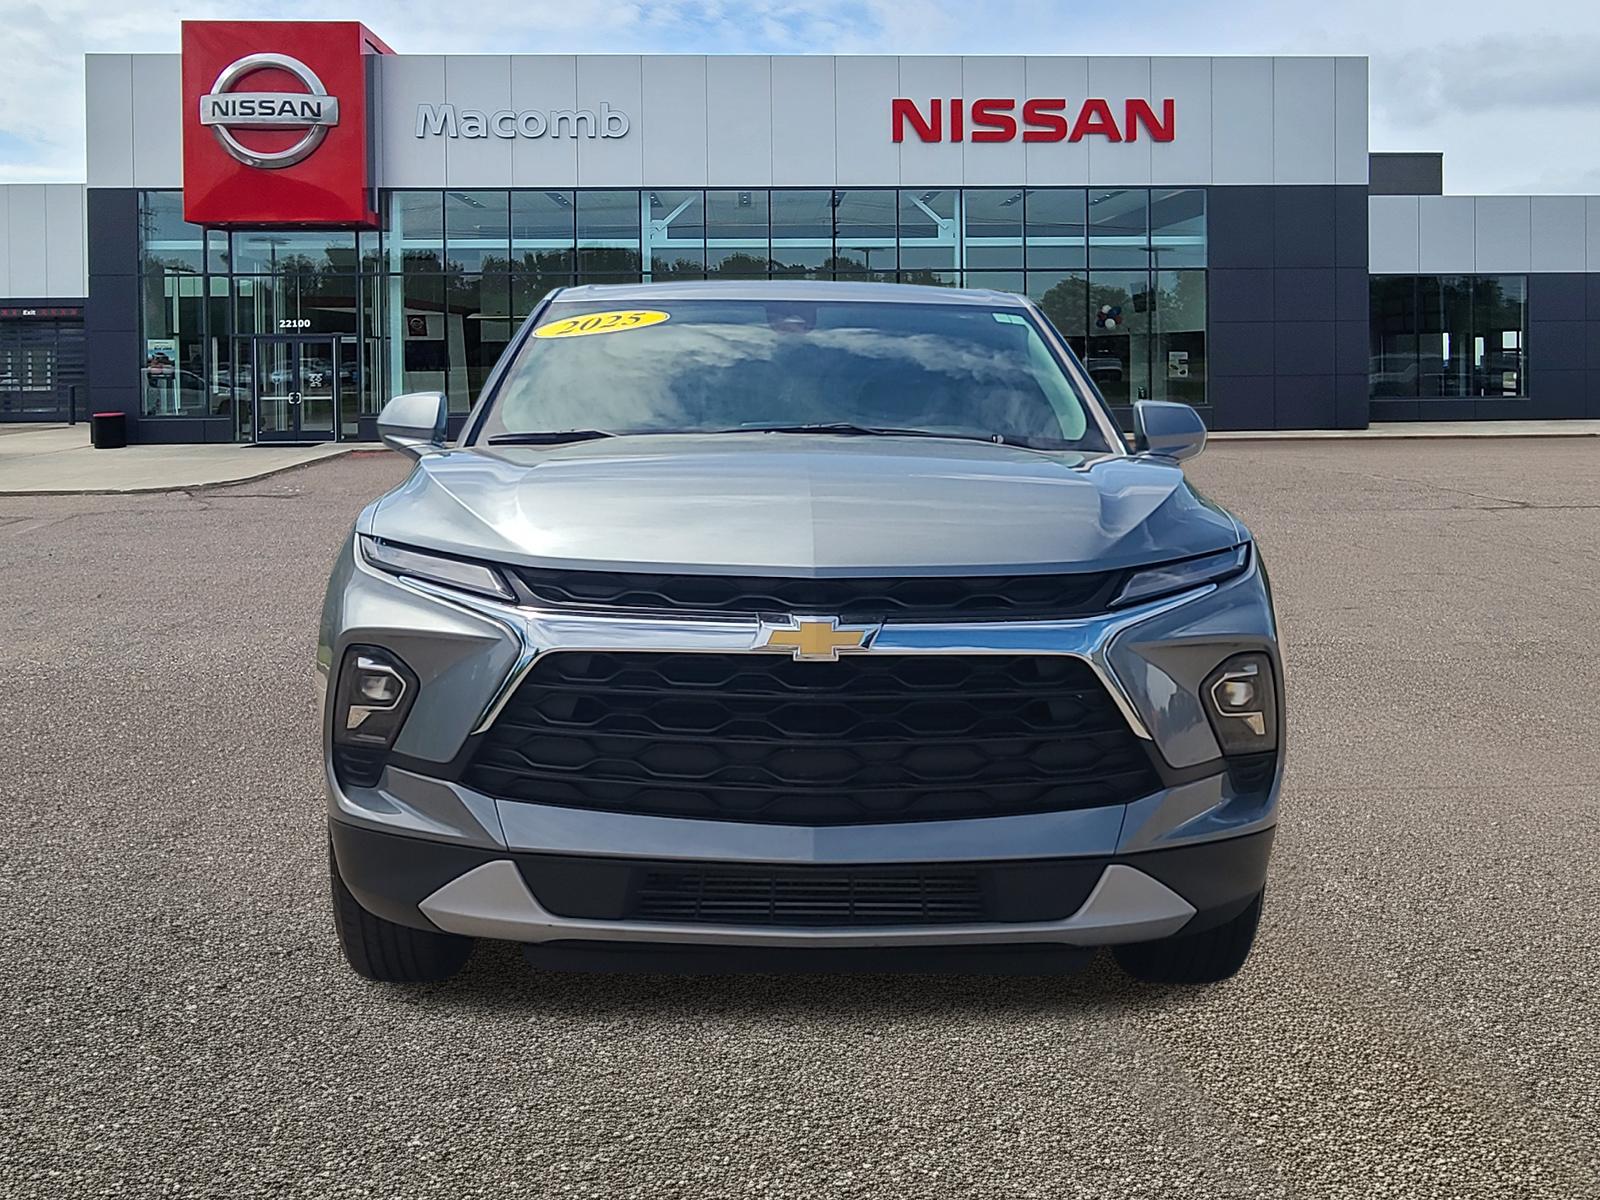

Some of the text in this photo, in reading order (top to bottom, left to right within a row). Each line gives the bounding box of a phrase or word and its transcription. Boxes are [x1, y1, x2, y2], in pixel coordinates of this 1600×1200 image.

[211, 100, 322, 118] NISSAN
[415, 102, 630, 139] Macomb
[891, 98, 1175, 143] NISSAN
[279, 319, 311, 328] 22100
[555, 312, 646, 334] 2025
